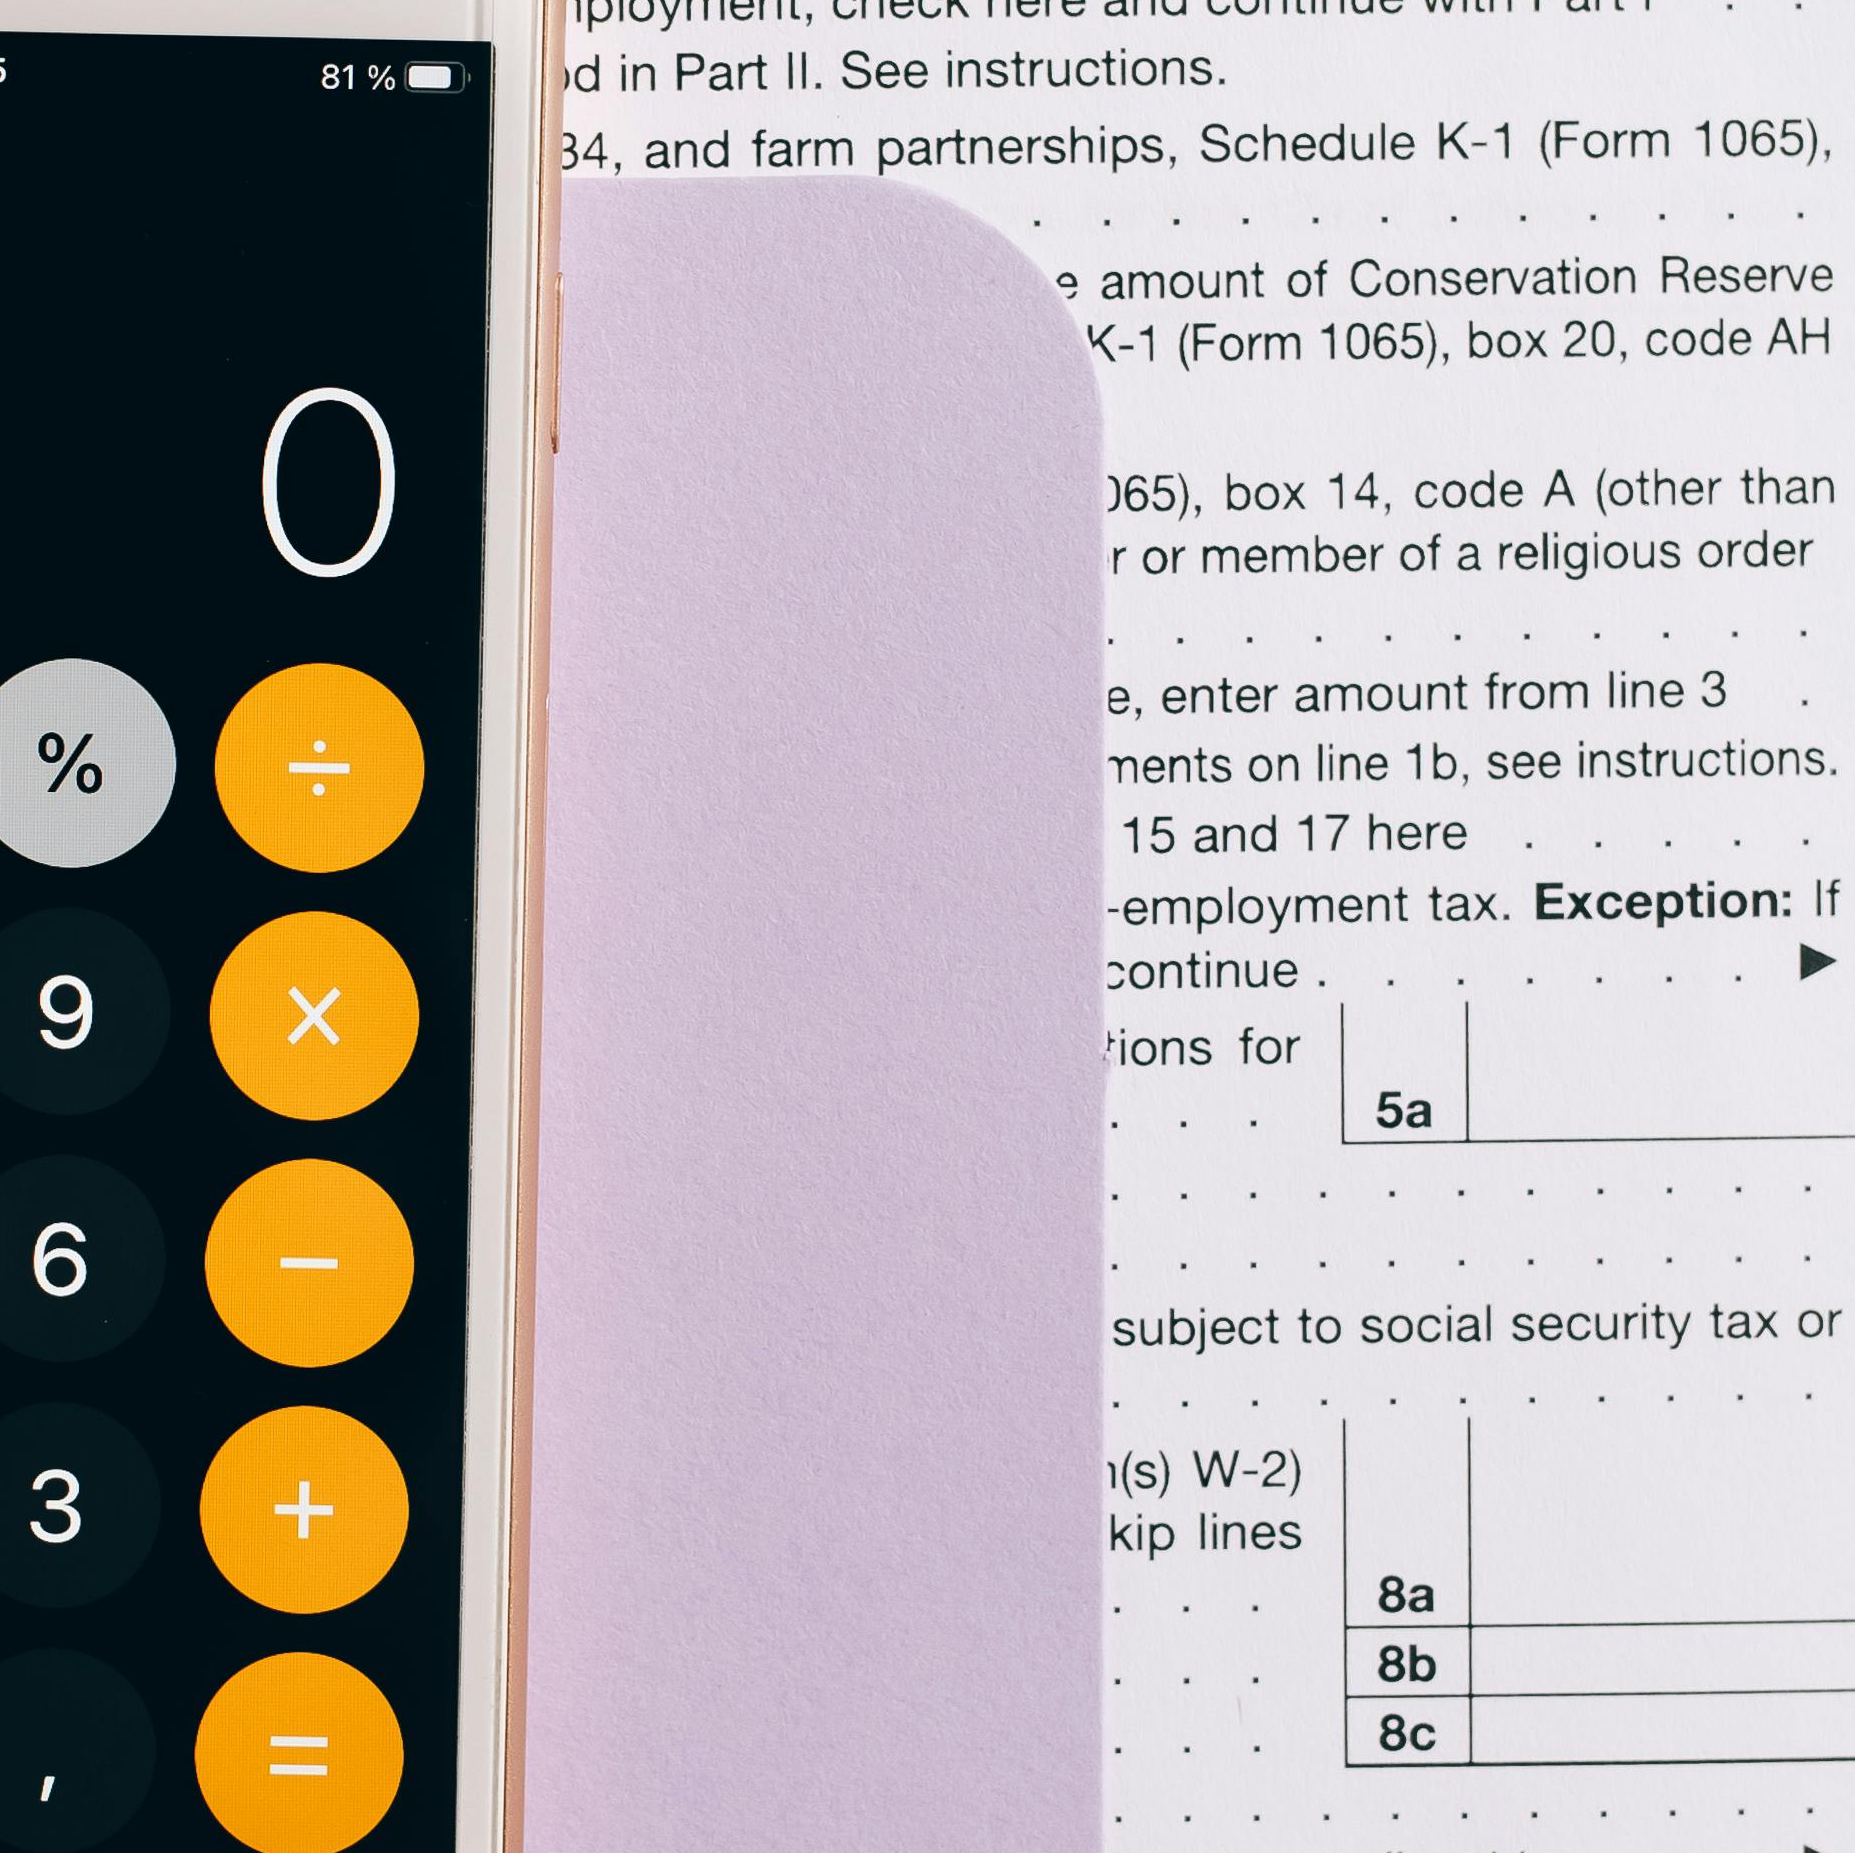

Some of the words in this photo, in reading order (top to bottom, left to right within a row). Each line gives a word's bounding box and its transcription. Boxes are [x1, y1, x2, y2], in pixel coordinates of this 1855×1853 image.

[322, 64, 353, 89] 81
[646, 130, 728, 168] and
[752, 129, 853, 167] farm
[879, 126, 1176, 176] partnerships,
[1201, 123, 1415, 162] Schedule
[1439, 122, 1509, 159] K-1
[1541, 120, 1669, 168] (Form
[1696, 119, 1830, 165] 1065),
[1102, 262, 1264, 300] amount
[1288, 260, 1327, 297] of
[1351, 257, 1635, 297] Conservation
[1662, 256, 1833, 293] Reserve
[263, 388, 395, 577] 0
[1429, 886, 1509, 921] tax.
[1536, 881, 1790, 928] Exception:
[1817, 879, 1840, 916] If
[40, 975, 92, 1049] 9
[1377, 1092, 1431, 1128] 5a
[34, 1222, 87, 1296] 6
[1114, 1308, 1279, 1355] subject
[1298, 1309, 1341, 1344] to
[1362, 1305, 1491, 1343] social
[1513, 1303, 1690, 1349] security
[1710, 1304, 1777, 1339] tax
[1799, 1310, 1842, 1338] or
[30, 1469, 81, 1543] 3
[1379, 1576, 1434, 1613] 8a
[1378, 1645, 1436, 1682] 8b
[1380, 1714, 1435, 1751] 8c
